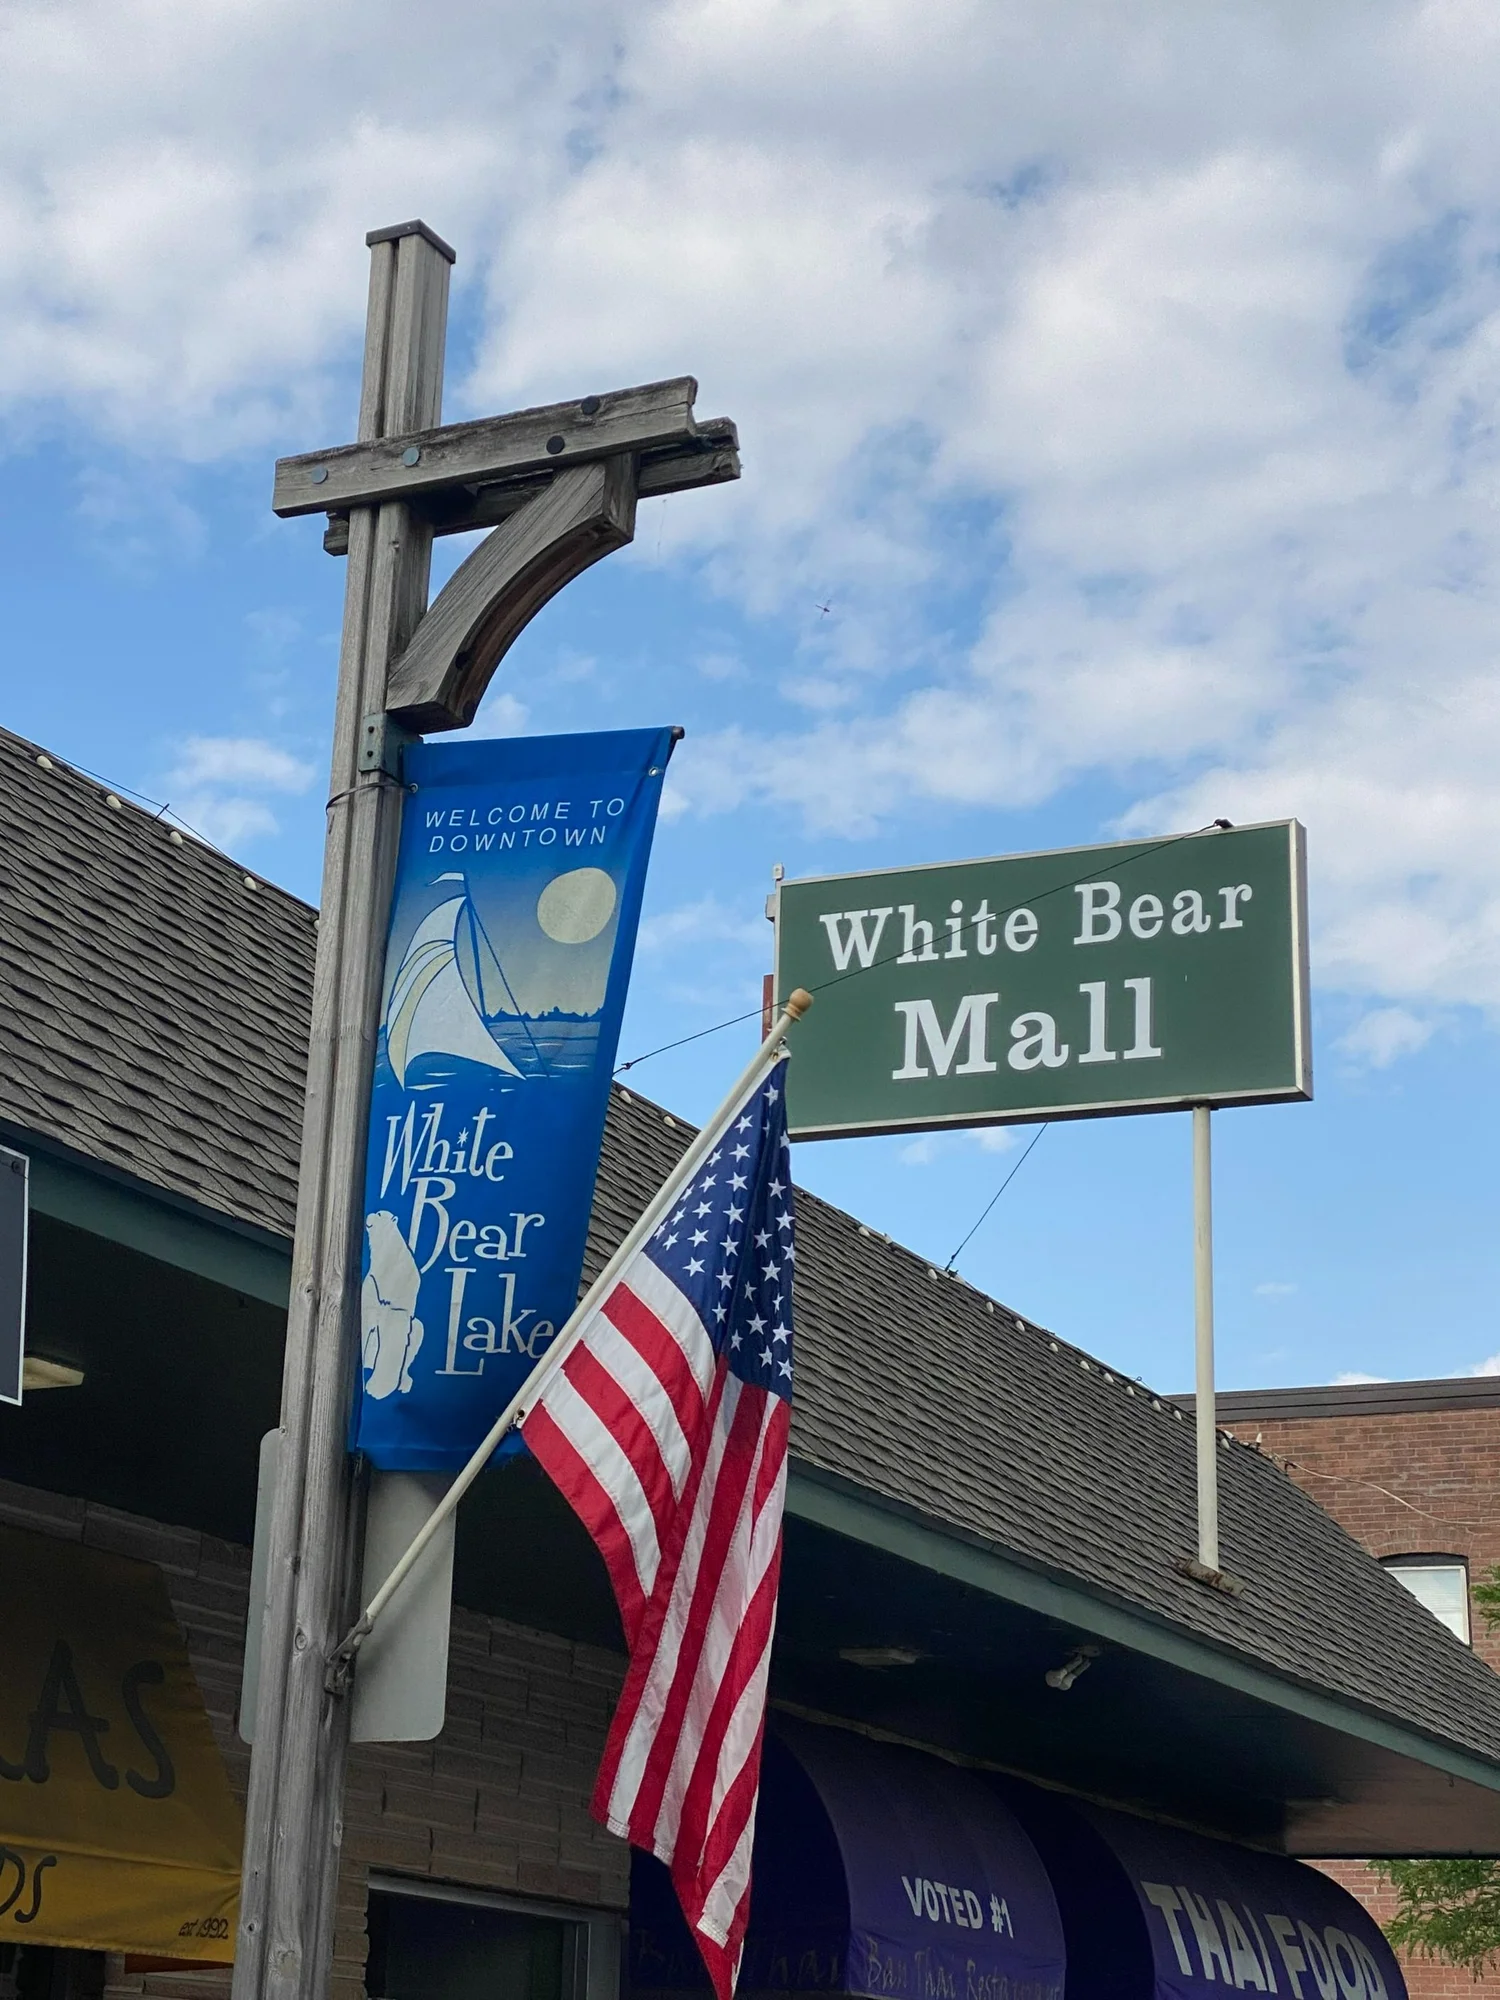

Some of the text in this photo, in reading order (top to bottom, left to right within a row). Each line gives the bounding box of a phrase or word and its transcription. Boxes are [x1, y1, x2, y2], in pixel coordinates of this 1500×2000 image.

[425, 797, 625, 828] WELCOME TO
[429, 826, 607, 853] DOWNTOWN
[819, 880, 1253, 971] White Bear
[892, 976, 1162, 1080] Mall
[380, 1100, 513, 1199] White
[408, 1176, 545, 1274] Bear
[435, 1267, 555, 1376] Lake
[0, 1638, 176, 1799] AS
[196, 1917, 229, 1940] 1992
[901, 1875, 1014, 1939] VOTED #1
[1140, 1880, 1389, 2000] THAI FOOD
